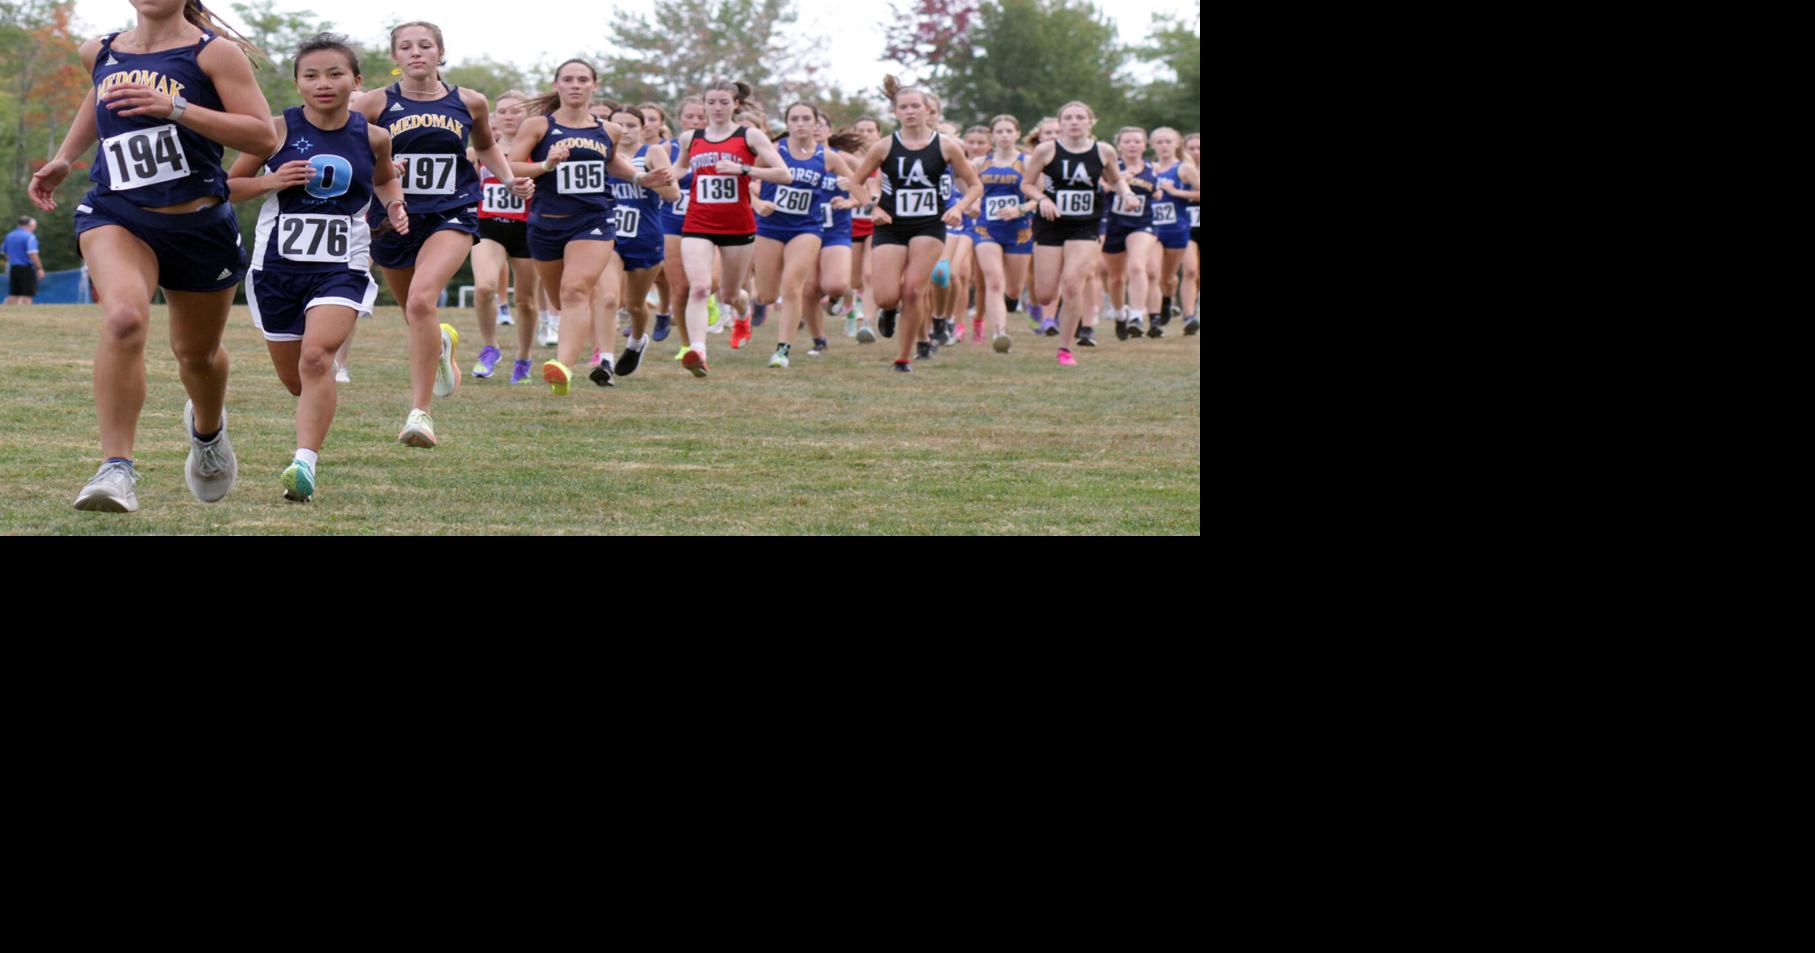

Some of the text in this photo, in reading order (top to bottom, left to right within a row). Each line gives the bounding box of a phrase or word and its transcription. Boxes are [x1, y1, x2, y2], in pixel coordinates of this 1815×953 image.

[389, 113, 464, 140] MEDOMAK
[110, 130, 182, 182] 194
[402, 157, 454, 189] 197
[561, 164, 601, 189] 195
[789, 167, 821, 187] ORSE
[897, 156, 936, 188] LA
[1062, 159, 1094, 187] LA
[701, 178, 735, 200] 139
[777, 189, 809, 211] 260
[900, 192, 934, 213] 174
[1061, 194, 1091, 212] 169
[1154, 204, 1174, 220] 62
[614, 209, 637, 233] 60
[283, 218, 348, 257] 276
